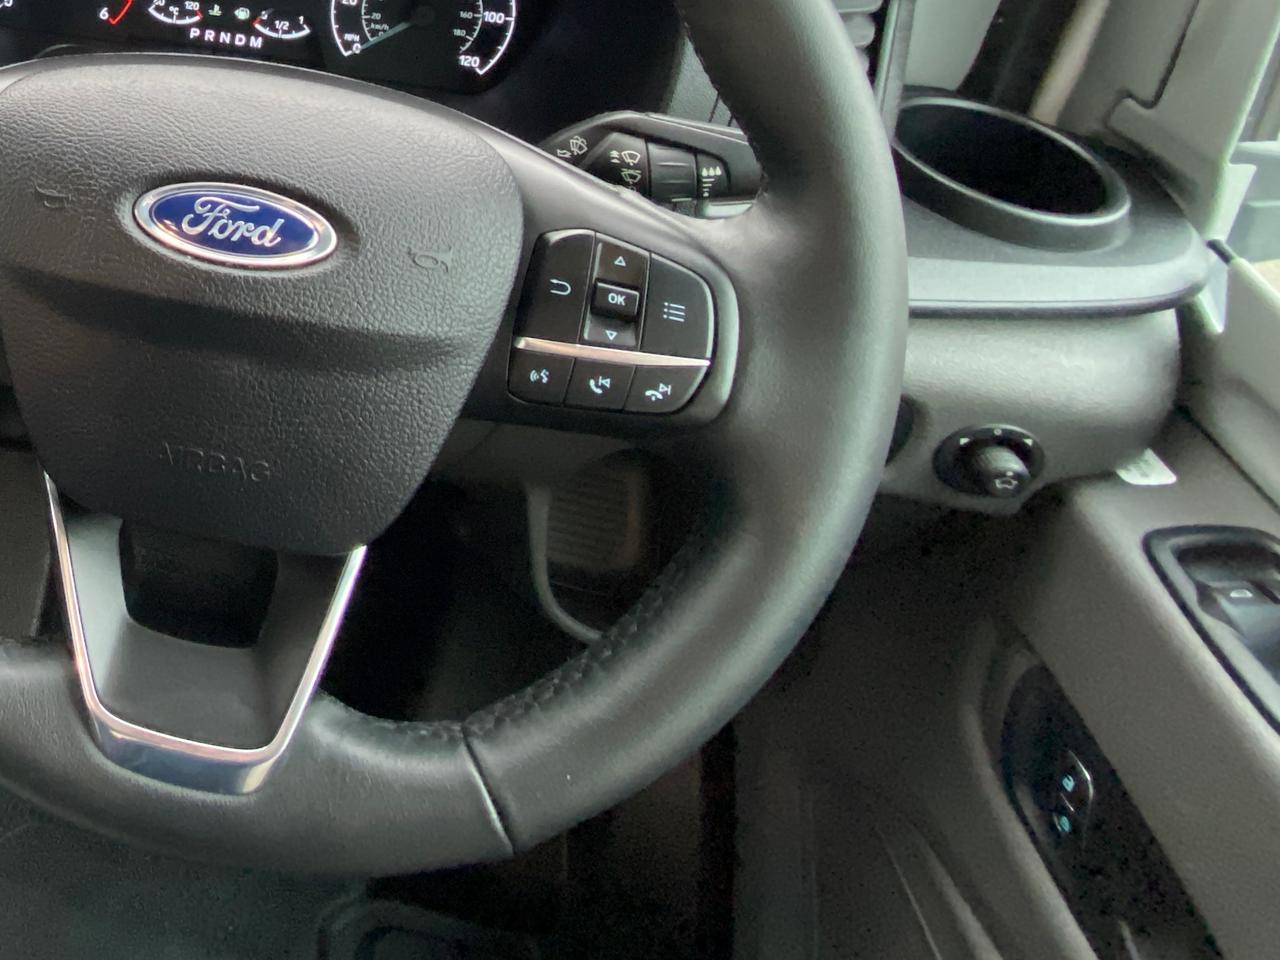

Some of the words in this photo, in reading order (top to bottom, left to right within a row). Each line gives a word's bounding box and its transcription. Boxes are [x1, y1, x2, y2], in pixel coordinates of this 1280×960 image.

[184, 0, 200, 11] 120
[99, 7, 109, 20] 6
[370, 12, 381, 20] 20
[460, 11, 473, 19] 160
[483, 11, 505, 24] 100
[275, 20, 290, 30] 1/2
[299, 16, 304, 25] 1
[190, 28, 201, 39] P
[204, 29, 215, 42] R
[220, 32, 231, 44] N
[235, 34, 246, 45] D
[249, 36, 262, 48] M
[353, 43, 361, 54] 0
[458, 55, 480, 68] 120
[181, 196, 285, 247] Ford
[608, 292, 626, 306] OK
